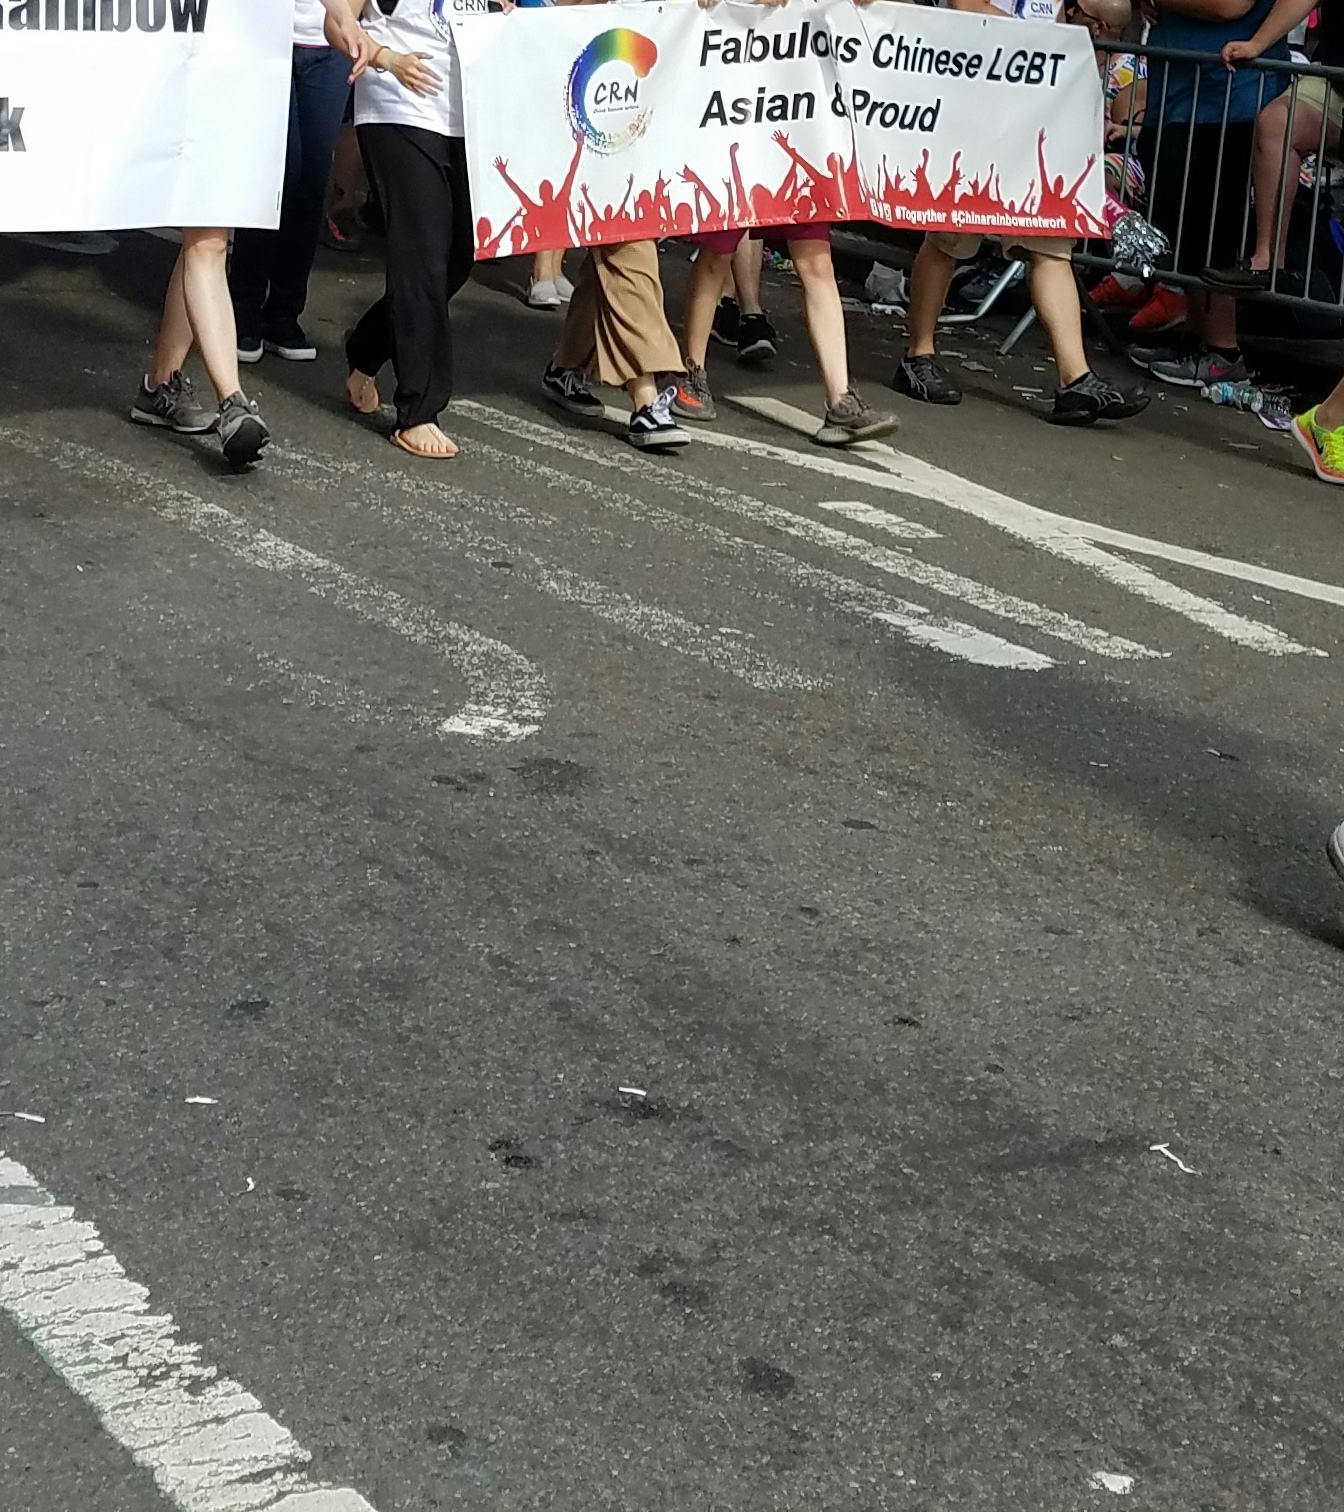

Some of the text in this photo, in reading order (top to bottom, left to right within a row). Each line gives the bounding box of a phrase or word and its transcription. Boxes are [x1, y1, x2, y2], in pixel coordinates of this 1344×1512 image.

[1030, 1, 1053, 15] CRN
[700, 21, 1066, 87] Fabulous Chinese LGBT
[594, 79, 638, 105] CRN
[699, 81, 941, 133] Asian & Proud
[895, 206, 1068, 230] #Togayther #Chinarainbownetwork
